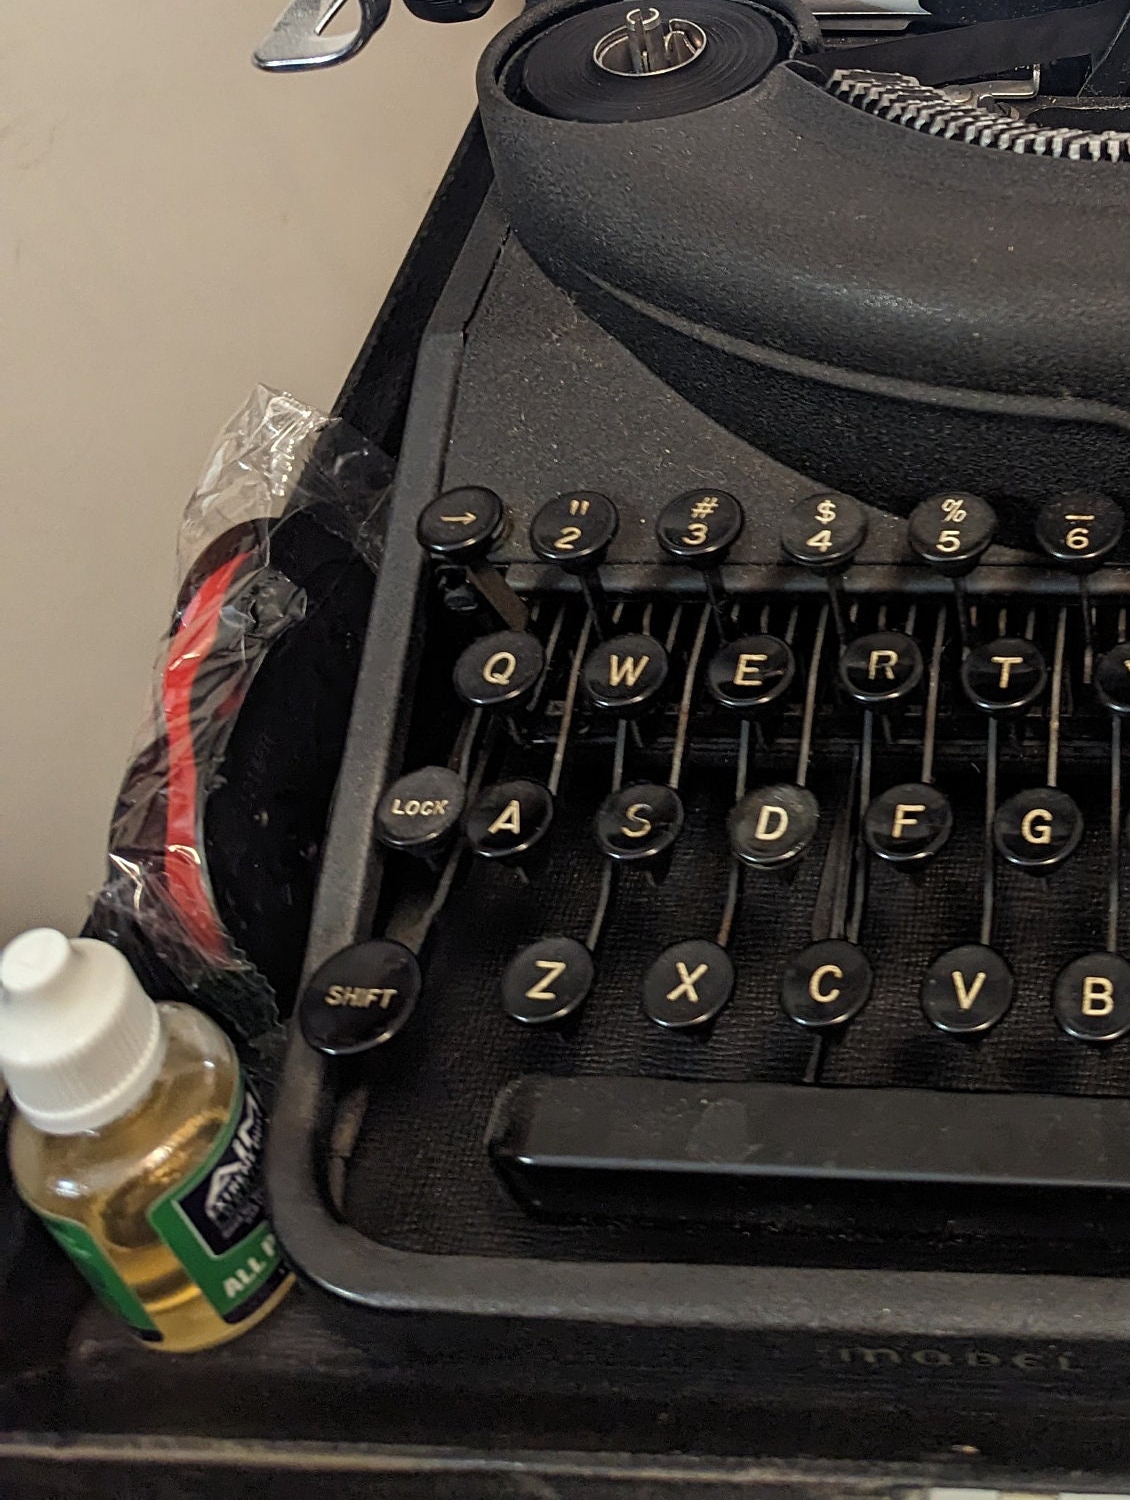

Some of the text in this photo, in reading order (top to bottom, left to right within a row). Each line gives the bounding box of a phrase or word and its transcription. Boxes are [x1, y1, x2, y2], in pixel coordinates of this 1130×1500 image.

[692, 496, 719, 519] #
[814, 499, 836, 525] $
[941, 498, 967, 523] %
[554, 526, 579, 550] 2
[682, 523, 709, 547] 3
[806, 529, 833, 552] 4
[936, 530, 961, 553] 5
[1066, 527, 1089, 549] 6
[483, 651, 516, 685] Q
[610, 654, 650, 686] W
[734, 653, 768, 686] E
[868, 650, 898, 679] R
[991, 656, 1024, 688] T
[391, 798, 449, 816] LOCK
[487, 799, 520, 834] A
[621, 803, 652, 838] S
[754, 805, 789, 841] D
[892, 804, 926, 838] F
[1021, 808, 1053, 844] G
[326, 985, 398, 1007] SHIFT
[526, 960, 562, 1000] Z
[666, 962, 708, 1002] X
[810, 964, 842, 1003] C
[952, 971, 986, 1009] V
[1082, 976, 1114, 1016] B
[222, 1256, 267, 1299] ALL
